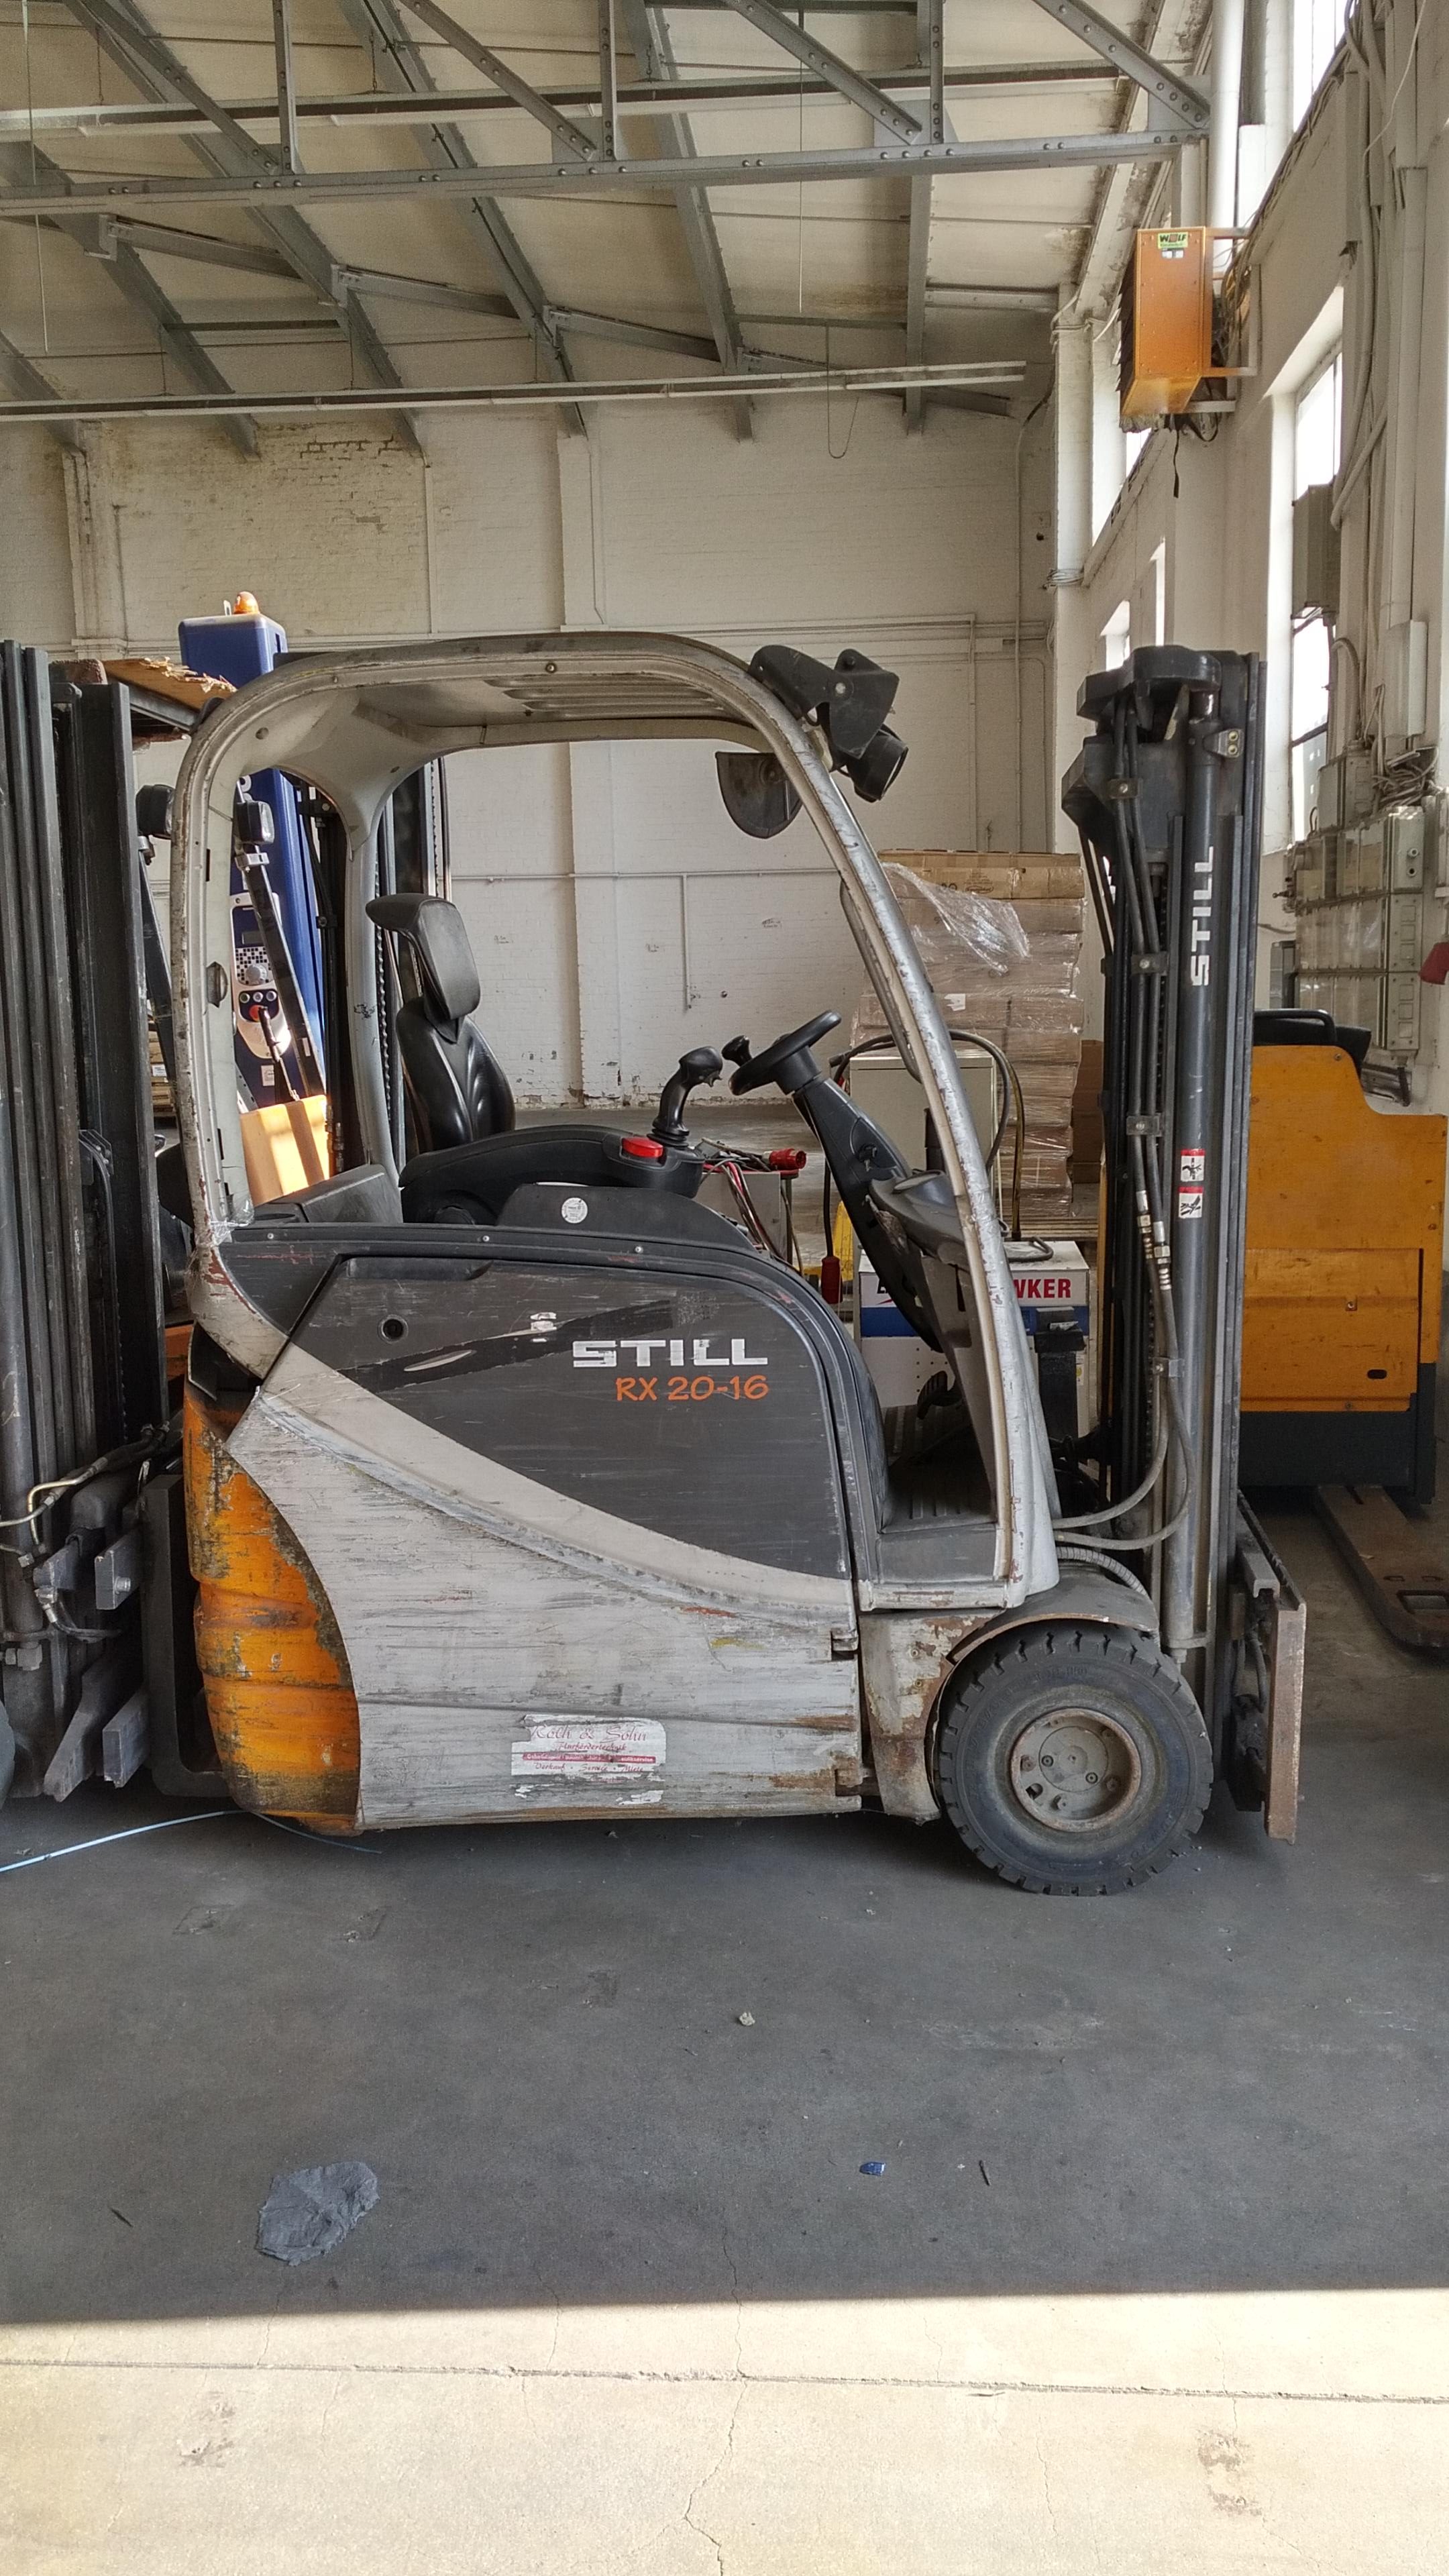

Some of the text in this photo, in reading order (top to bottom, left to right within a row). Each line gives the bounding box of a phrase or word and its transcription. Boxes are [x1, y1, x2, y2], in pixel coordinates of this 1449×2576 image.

[1190, 846, 1214, 985] STILL
[1012, 1279, 1071, 1298] WKER
[572, 1338, 768, 1367] STILL
[615, 1375, 769, 1401] RX 20-16
[602, 1725, 646, 1742] Sohn
